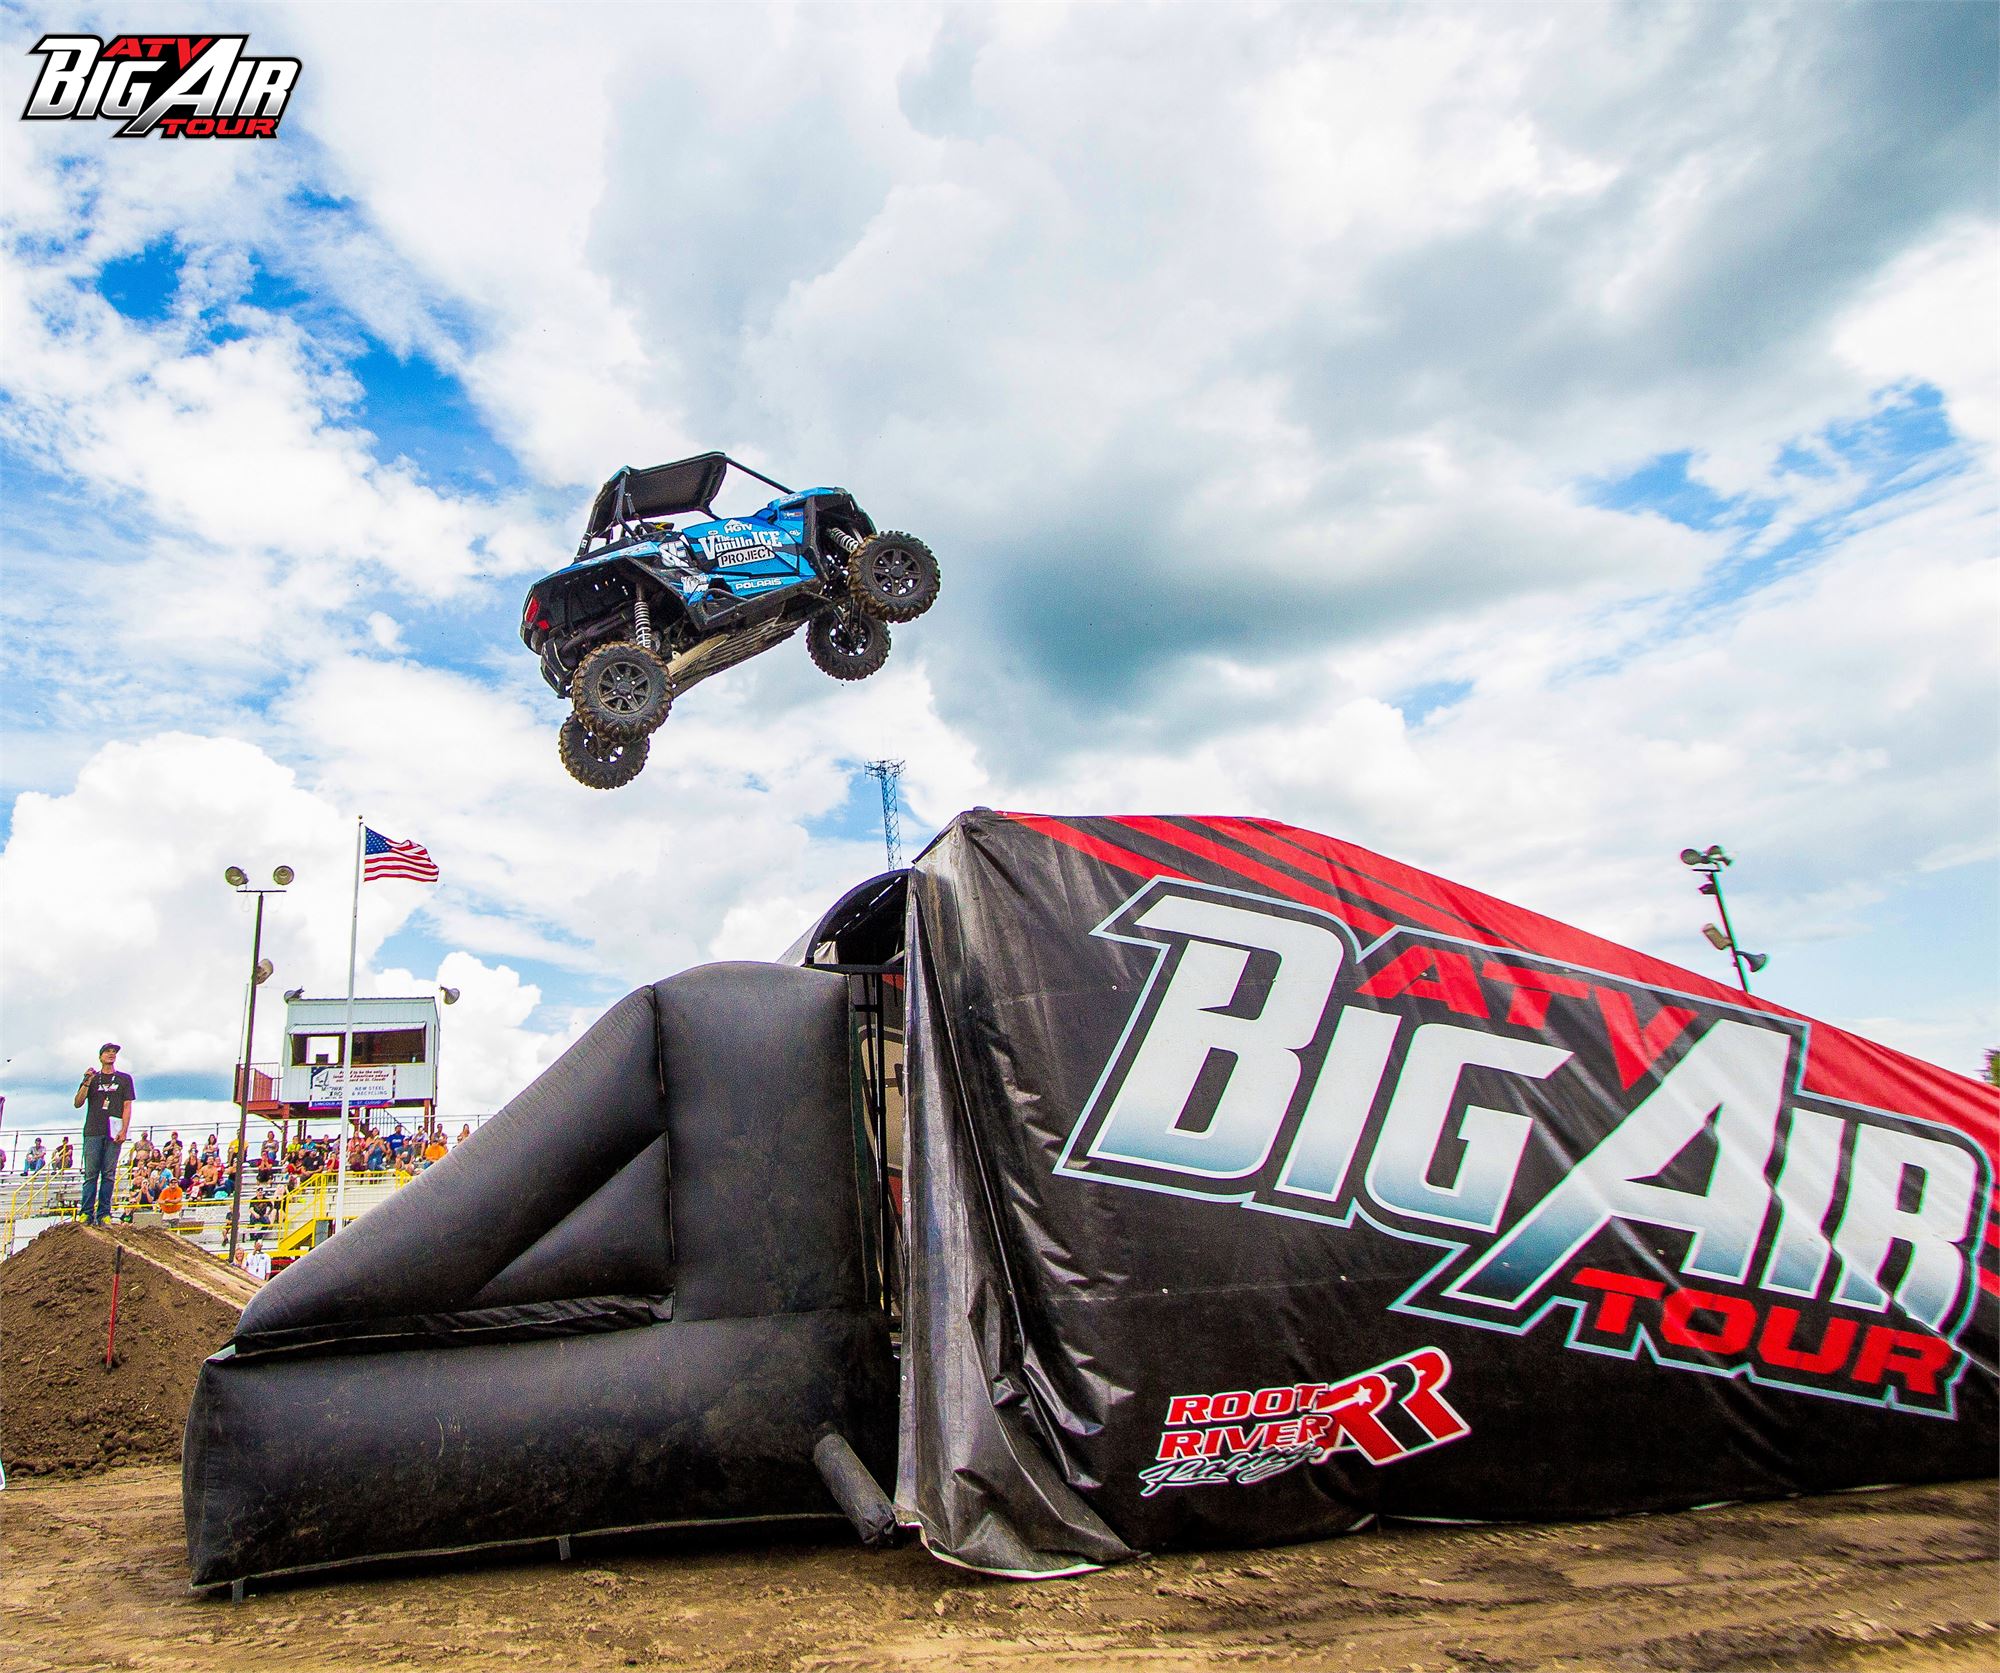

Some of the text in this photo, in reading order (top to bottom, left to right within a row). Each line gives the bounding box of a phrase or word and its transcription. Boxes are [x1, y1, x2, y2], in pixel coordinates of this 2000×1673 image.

[698, 535, 754, 561] Vanilla
[751, 531, 783, 549] ICE
[724, 522, 753, 534] HGTV
[720, 548, 774, 566] PROJECT
[735, 578, 783, 591] POLARIS
[1356, 944, 1699, 1093] ATV
[1086, 894, 1979, 1333] BIG AIR
[1571, 1266, 1956, 1396] TOUR
[1164, 1382, 1330, 1426] ROOT
[1155, 1413, 1334, 1463] RIVER
